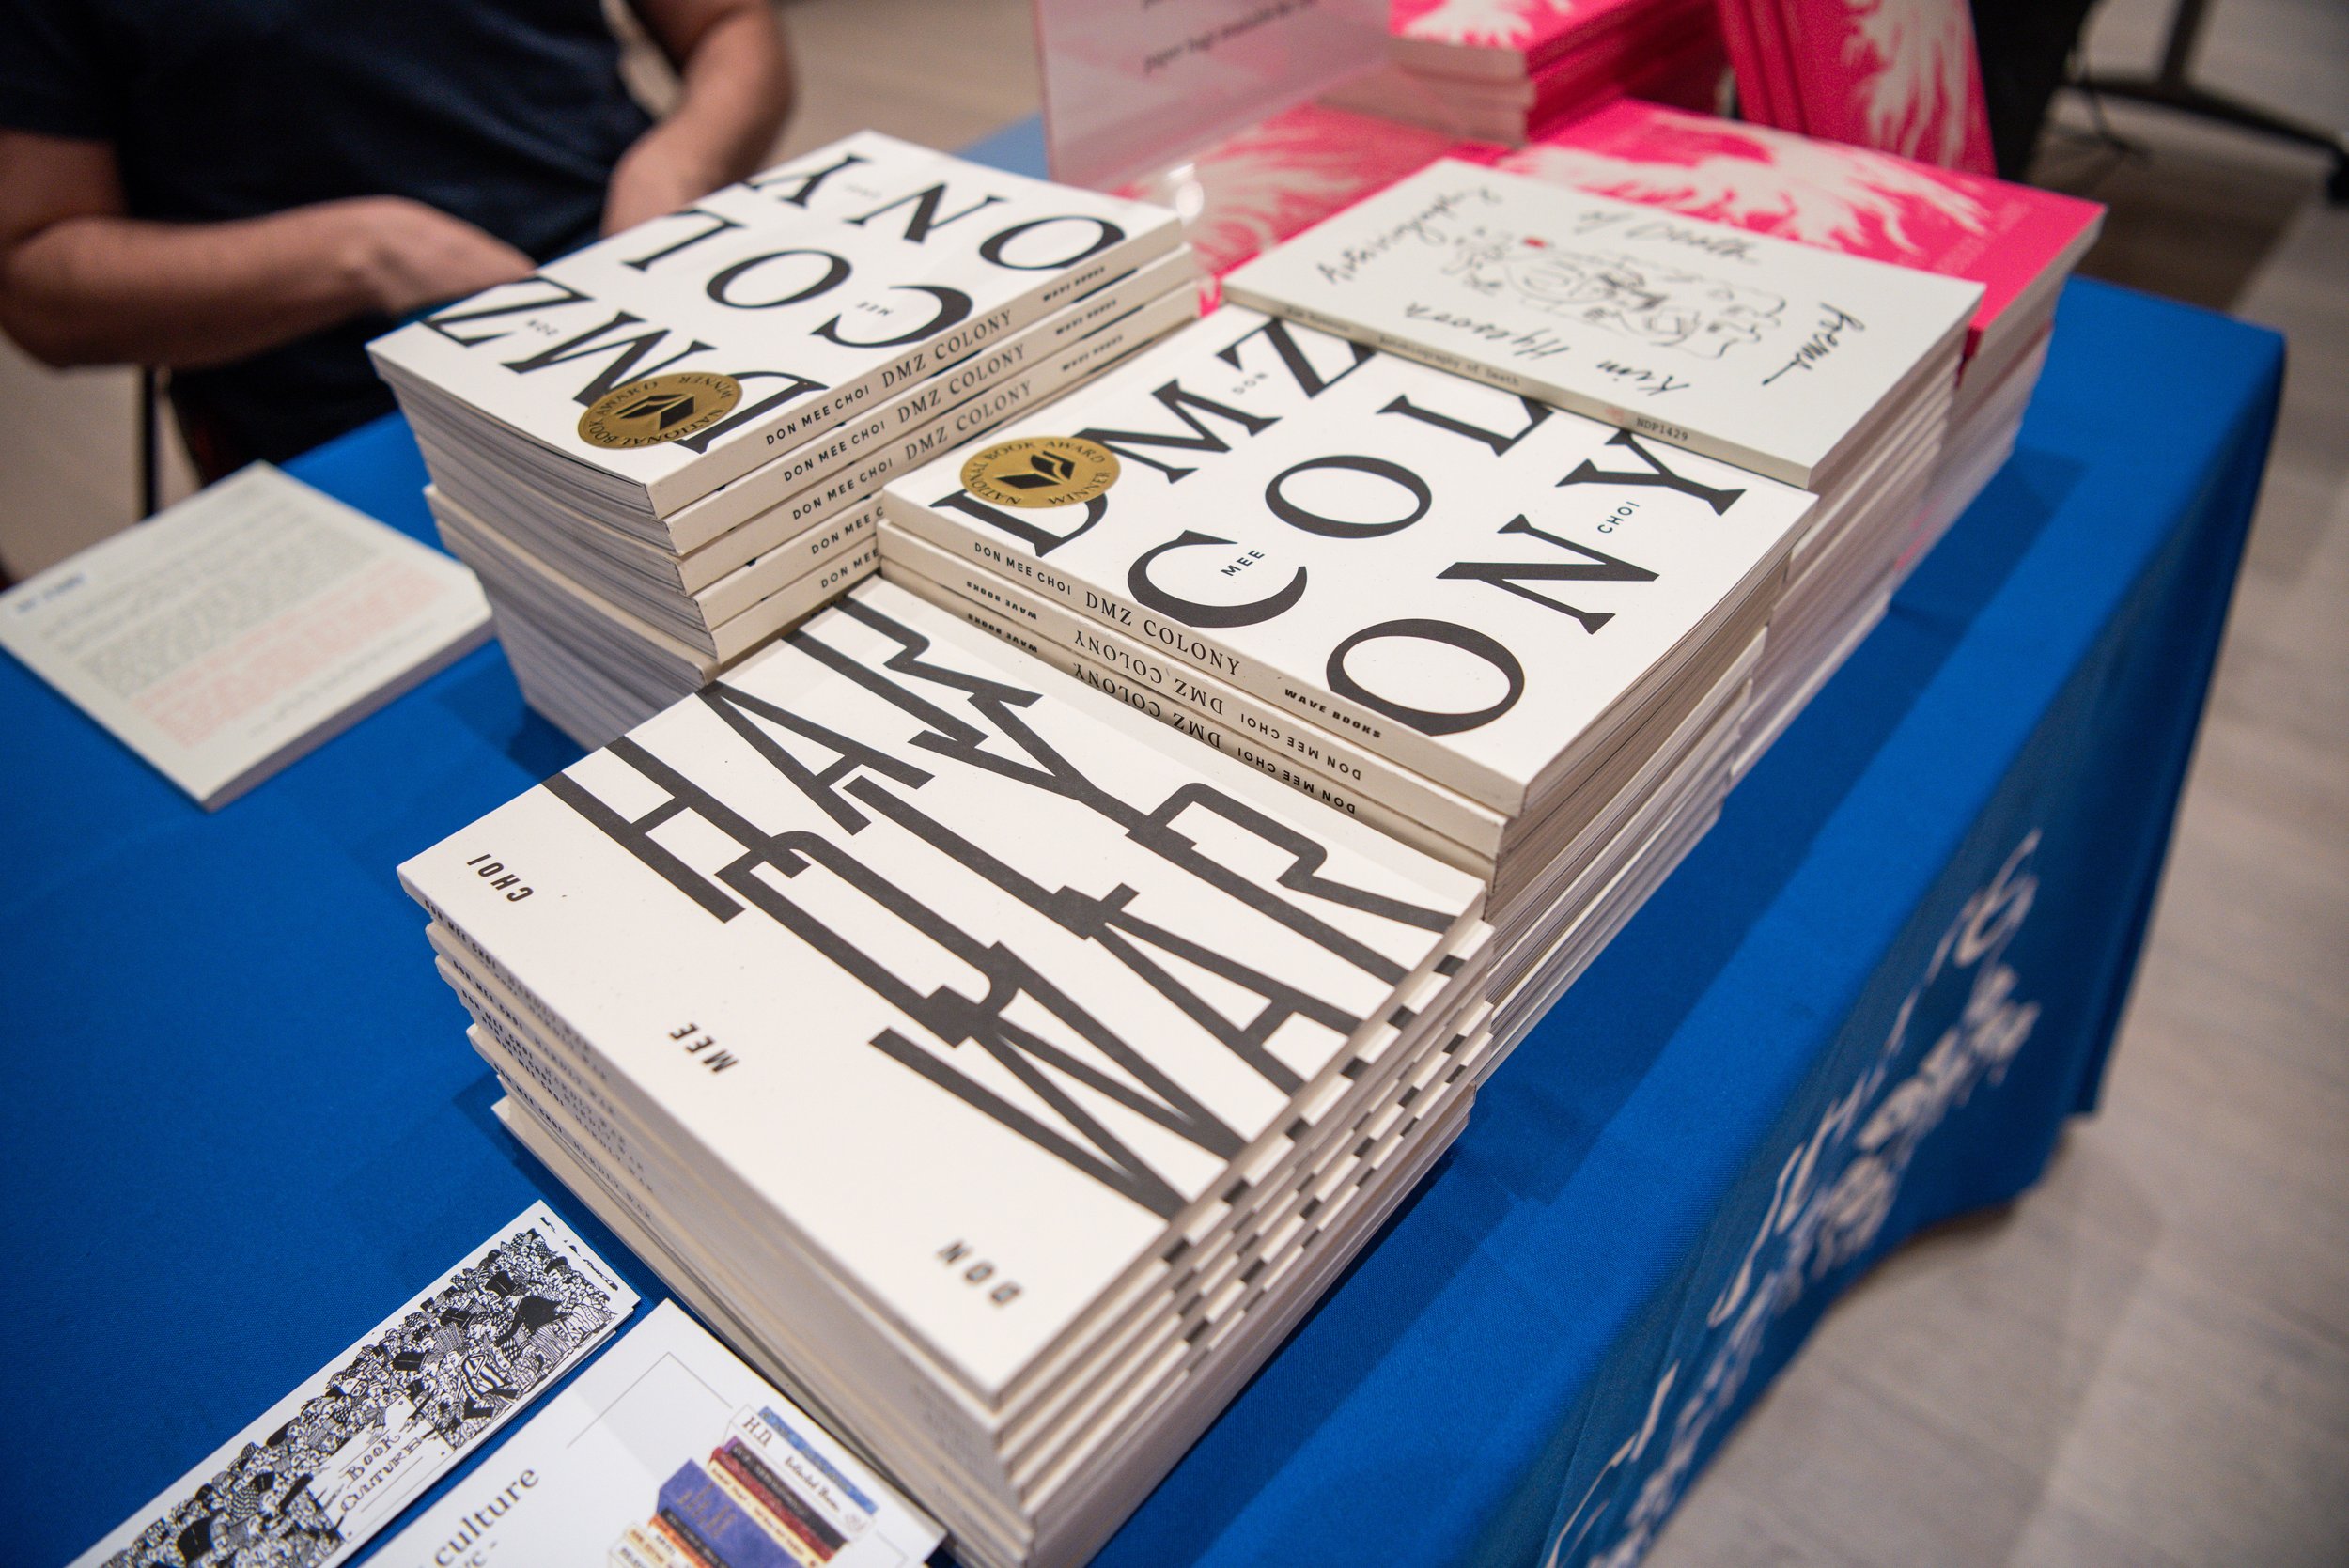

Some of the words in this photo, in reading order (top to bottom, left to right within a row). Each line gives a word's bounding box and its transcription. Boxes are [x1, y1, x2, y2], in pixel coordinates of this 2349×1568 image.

[677, 376, 733, 399] WINNER
[766, 423, 797, 446] DON
[801, 406, 831, 427] MEE
[834, 385, 870, 410] CHOI
[881, 353, 926, 389] DMZ
[934, 309, 1012, 361] COLONY
[1596, 360, 1690, 396] Kim
[596, 380, 658, 416] AWARD
[784, 458, 814, 482] DON
[818, 441, 848, 463] MEE
[851, 420, 886, 445] CHOI
[897, 388, 941, 424] DMZ
[949, 343, 1027, 396] COLONY
[588, 418, 617, 444] BOOK
[623, 408, 724, 447] NATIONAL
[1636, 418, 1689, 442] NDP1429
[792, 496, 822, 520] DON
[827, 479, 855, 501] MEE
[859, 458, 894, 483] CHOI
[904, 424, 948, 462] DMZ
[955, 380, 1034, 433] COLONY
[984, 441, 1037, 462] BOOK
[1045, 440, 1106, 464] AWARD
[968, 461, 1023, 505] NATIONAL
[1048, 471, 1112, 505] WINNER
[811, 532, 840, 555] DON
[845, 513, 872, 536] MEE
[1596, 501, 1641, 535] CHOI
[820, 566, 848, 589] DON
[853, 547, 879, 569] MEE
[1220, 549, 1266, 577] MEE
[966, 580, 1001, 602] BOOKS
[967, 613, 1002, 635] BOOKS
[1005, 598, 1037, 620] WAVE
[974, 541, 1001, 563] DON
[1005, 556, 1032, 577] MEE
[1037, 571, 1071, 596] CHOI
[1085, 590, 1132, 627] DMZ
[1143, 619, 1240, 676] COLONY
[1284, 688, 1327, 714] WAVE
[1332, 710, 1382, 739] BOOKS
[1006, 631, 1038, 654] WAVE
[1074, 629, 1162, 685] COLONY
[1074, 662, 1161, 719] COLONY
[1174, 677, 1223, 715] DMZ
[1173, 712, 1221, 749] DMZ
[1240, 713, 1280, 740] CHOI
[1237, 747, 1276, 773] CHOI
[1287, 736, 1319, 760] MEE
[1283, 769, 1315, 794] MEE
[1327, 755, 1361, 781] DON
[1321, 789, 1356, 815] DON
[466, 853, 534, 903] CHOI
[668, 1022, 740, 1075] MEE
[938, 1239, 1021, 1307] DON
[434, 1469, 539, 1567] culture
